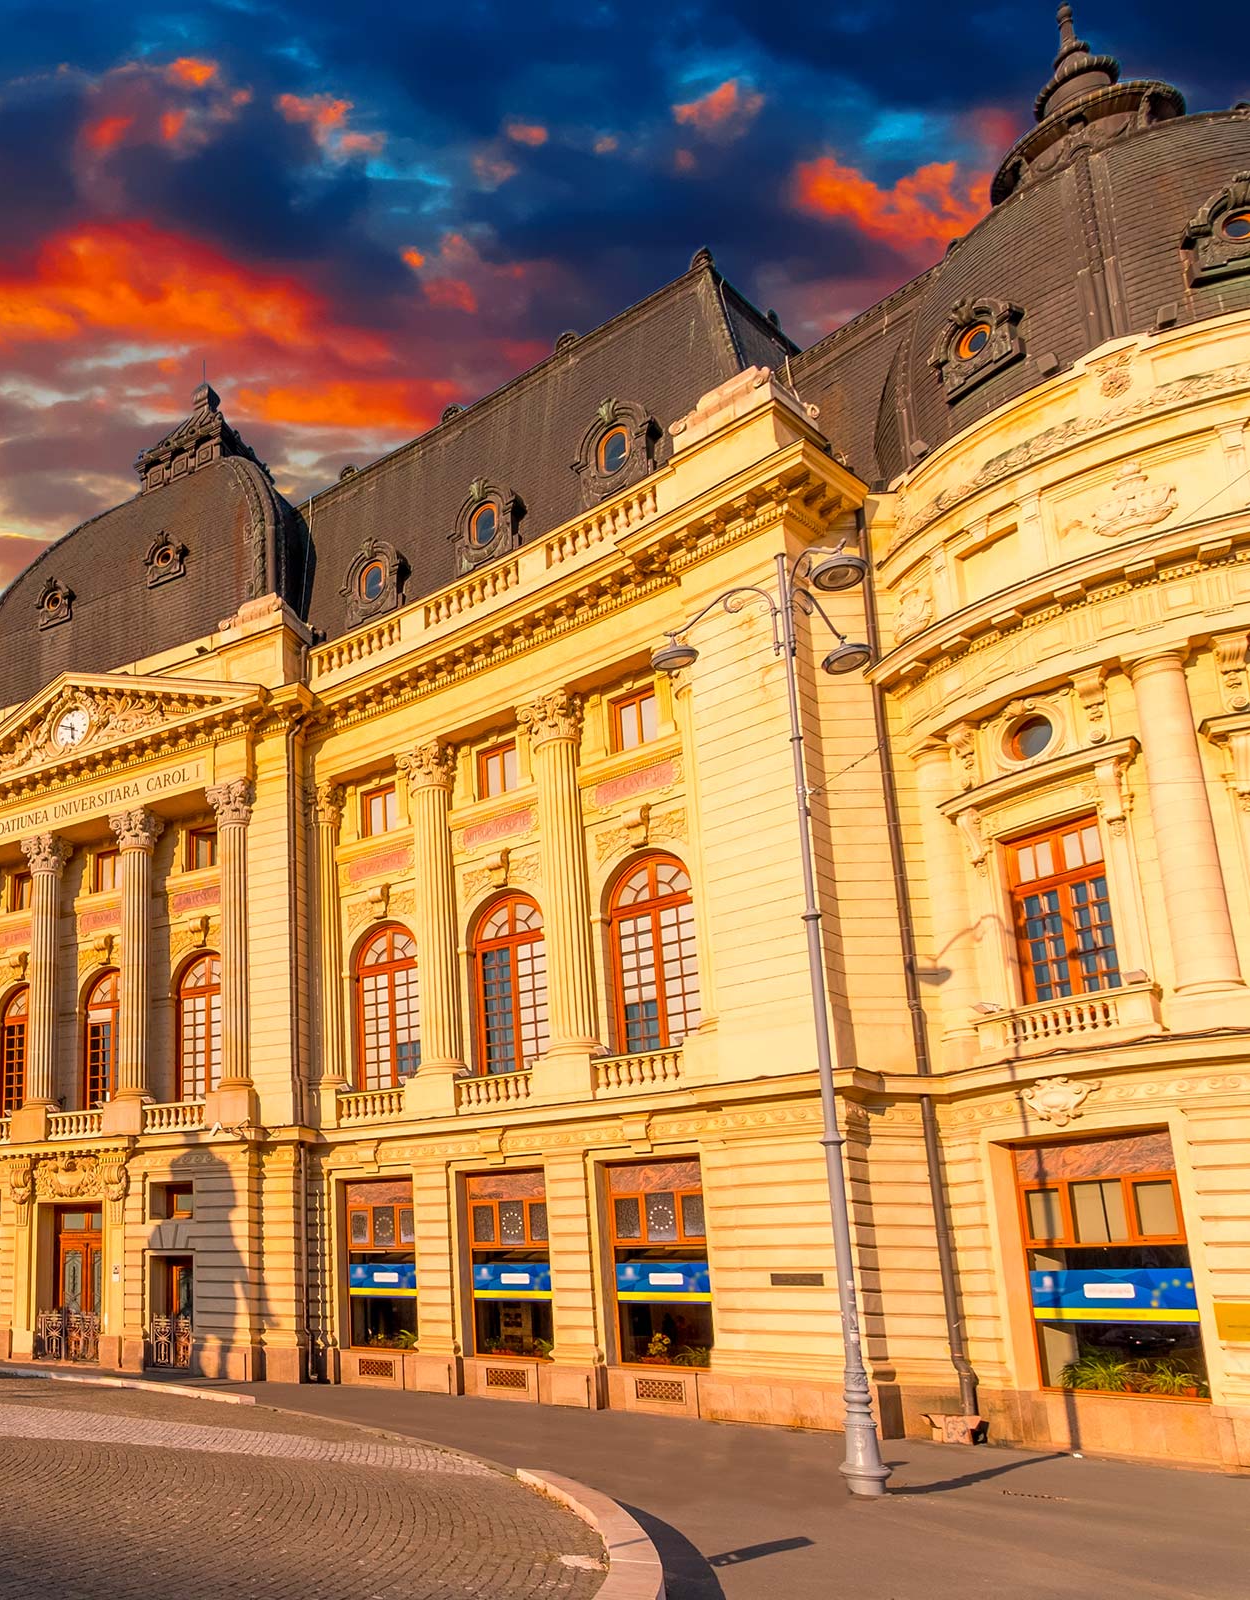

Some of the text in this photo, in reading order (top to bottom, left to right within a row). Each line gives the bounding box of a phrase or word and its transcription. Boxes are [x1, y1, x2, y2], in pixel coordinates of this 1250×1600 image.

[53, 783, 140, 819] UNIVERSITARA
[146, 768, 190, 791] CAROL
[195, 764, 200, 778] I
